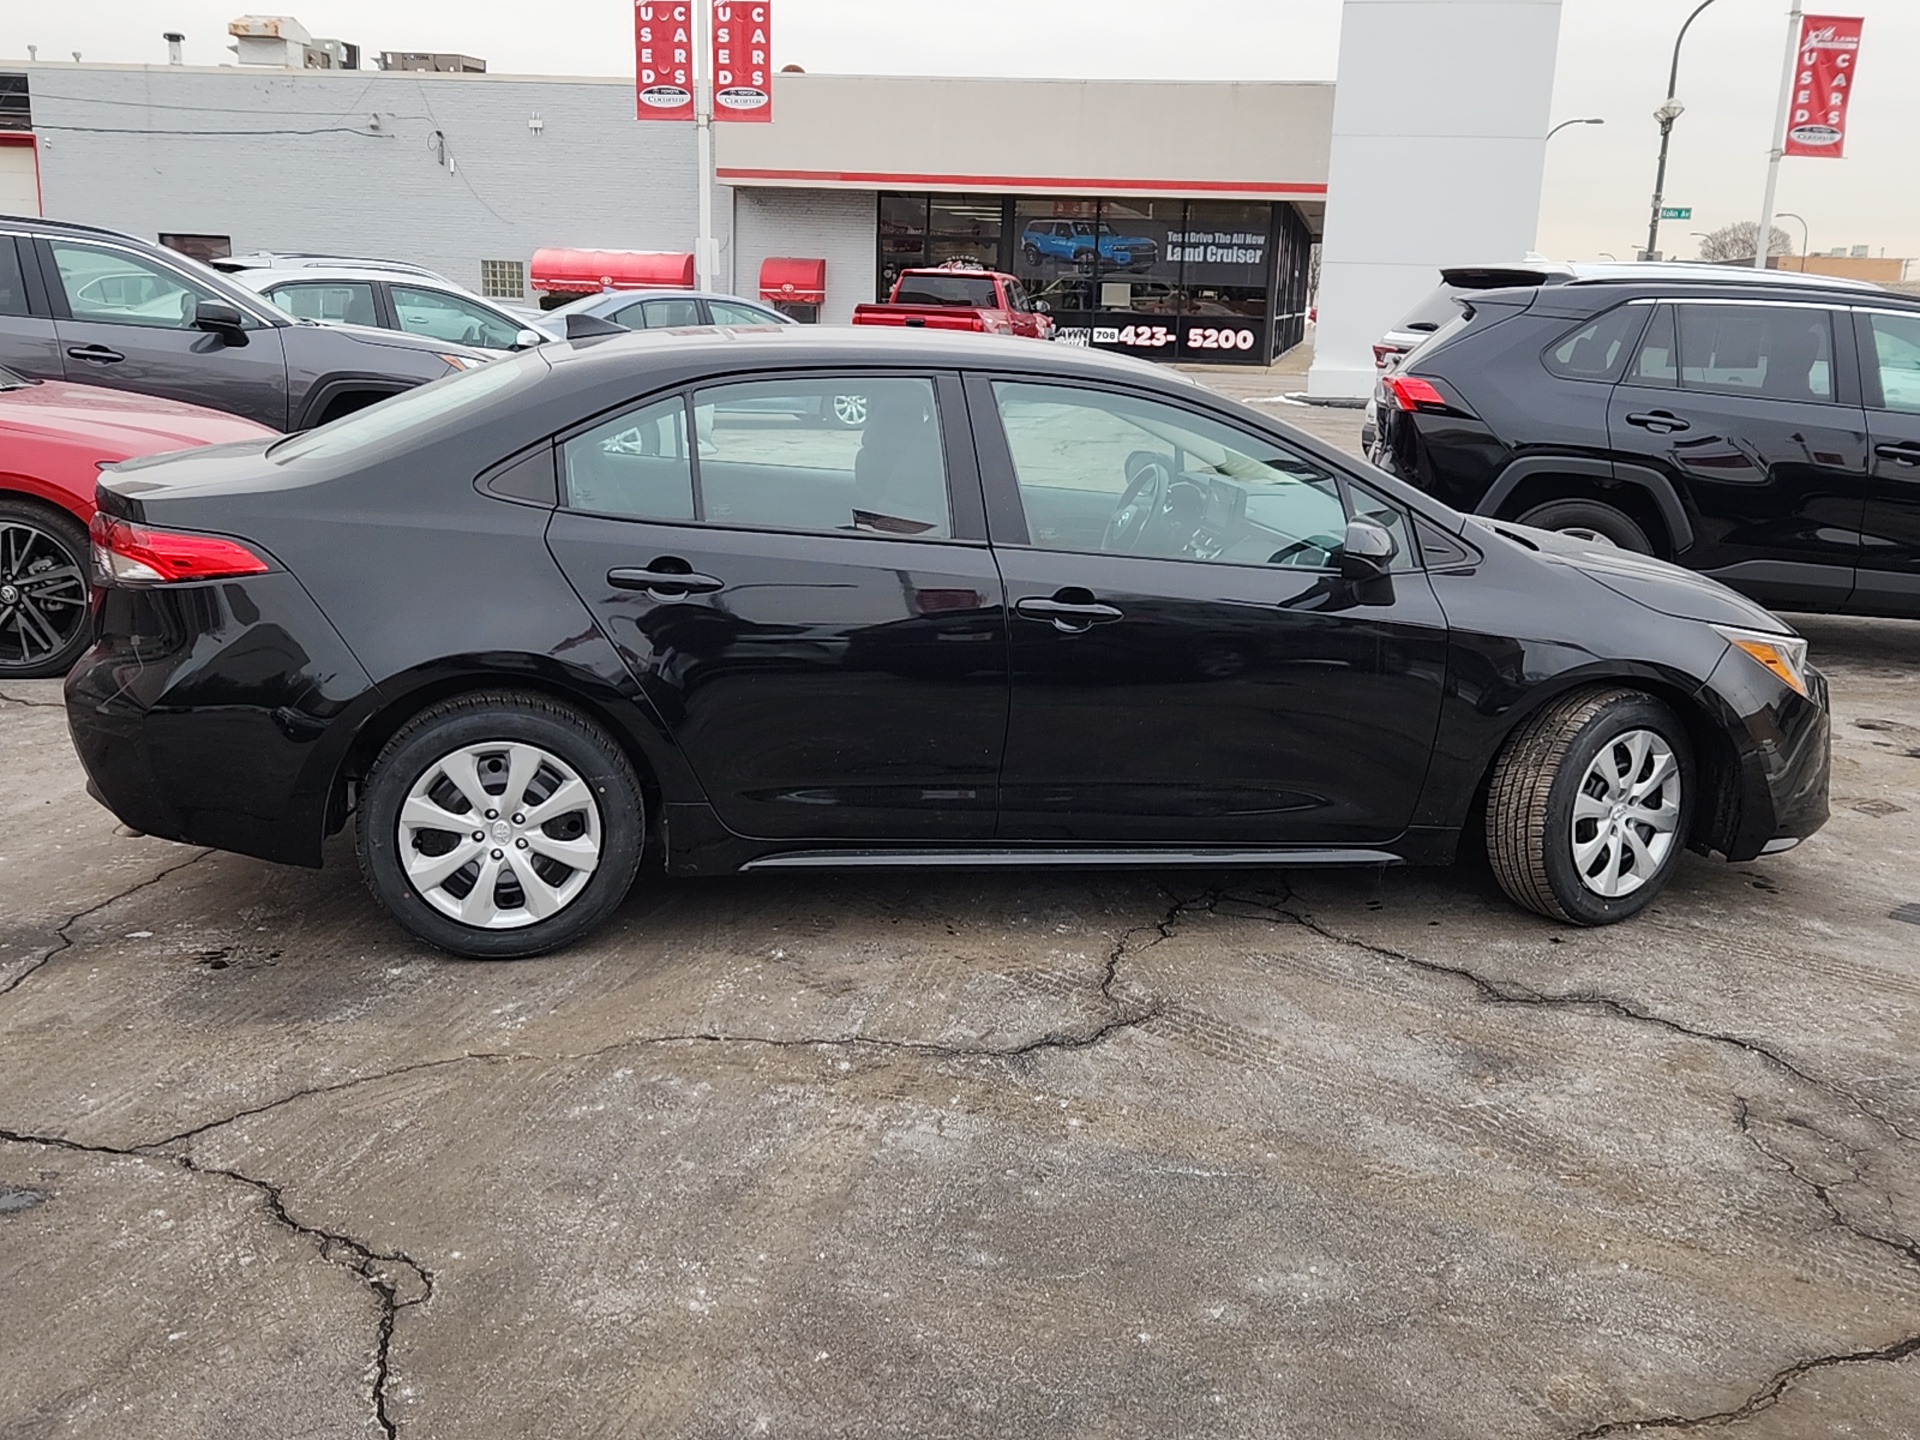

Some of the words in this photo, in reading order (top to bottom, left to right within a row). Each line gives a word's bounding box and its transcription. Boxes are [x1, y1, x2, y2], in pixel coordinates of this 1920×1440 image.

[640, 6, 656, 84] USED
[673, 6, 688, 85] CARS
[717, 6, 733, 85] USED
[751, 7, 766, 86] CARS
[1793, 52, 1818, 123] USED
[1826, 53, 1851, 125] CARS
[1166, 244, 1205, 263] Land
[1206, 245, 1263, 264] Cruiser
[1189, 232, 1214, 244] Drive
[1214, 232, 1232, 244] The
[1231, 233, 1245, 245] All
[1245, 233, 1266, 245] New
[1095, 331, 1116, 340] 708
[1118, 325, 1177, 347] 423-
[1187, 327, 1255, 350] 5200
